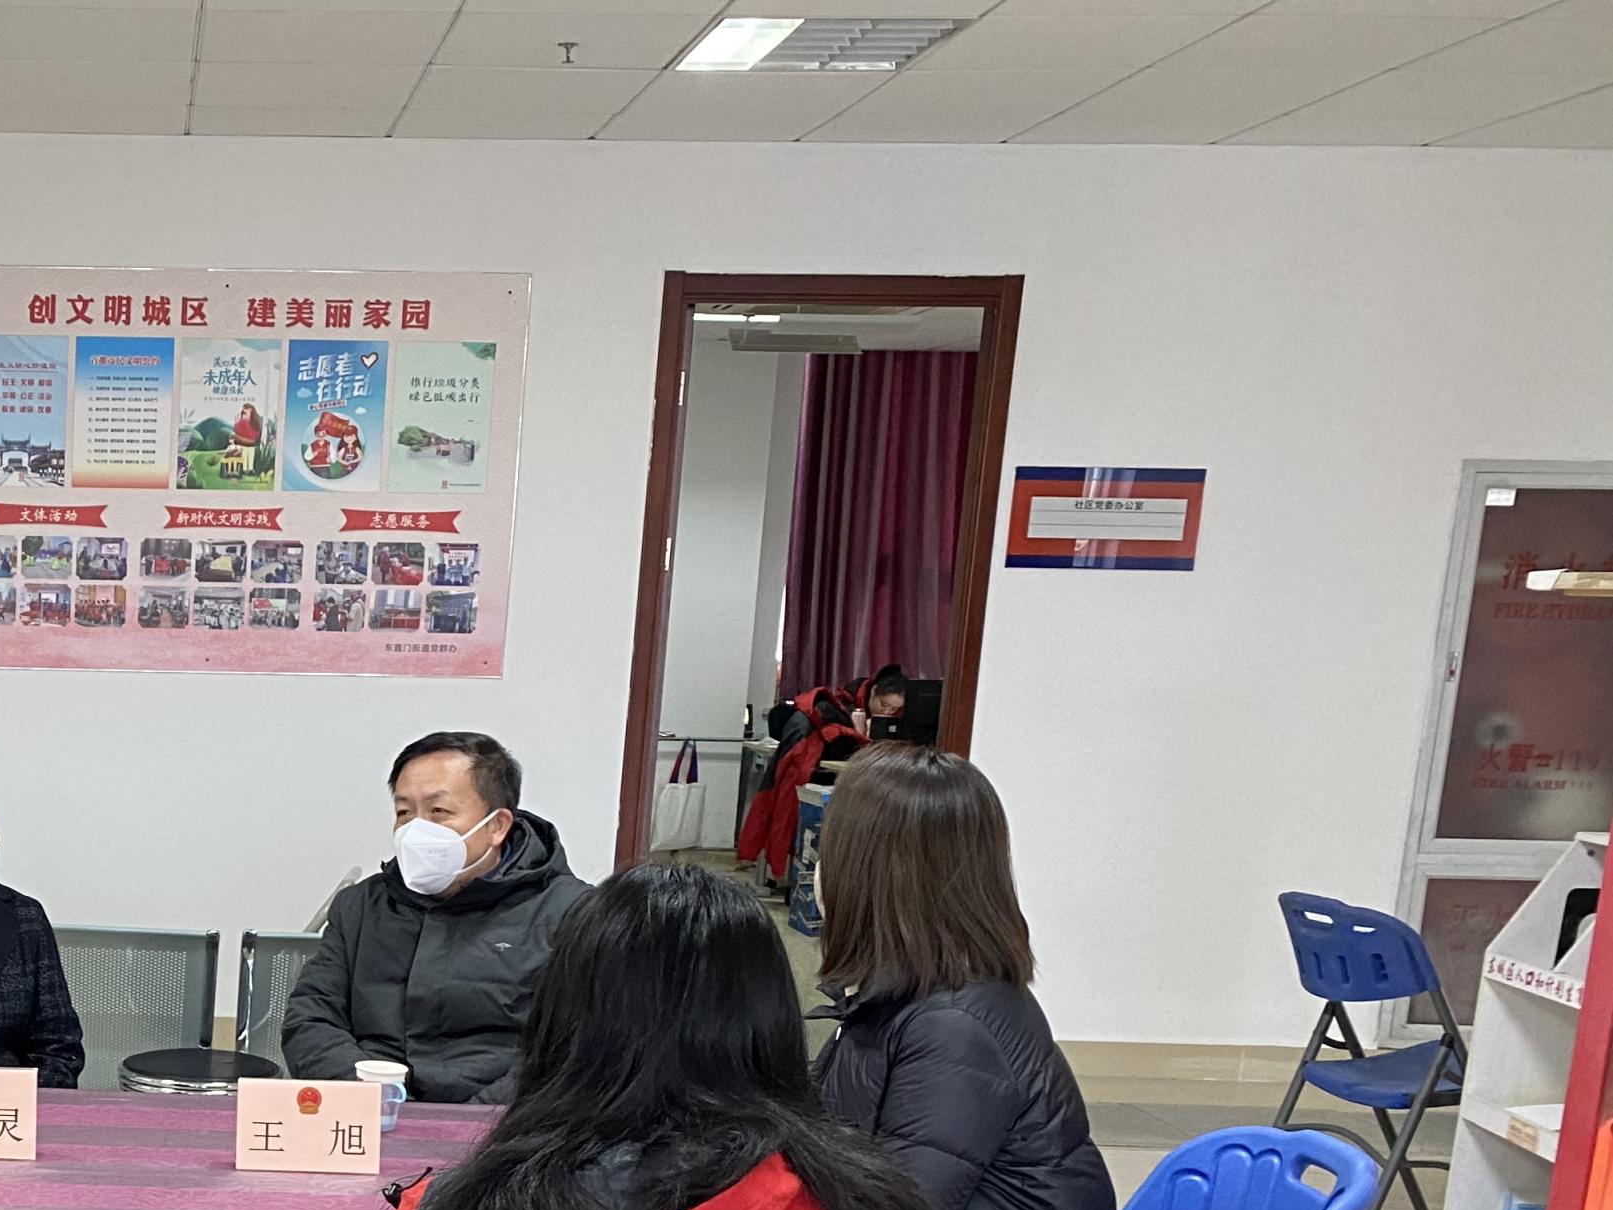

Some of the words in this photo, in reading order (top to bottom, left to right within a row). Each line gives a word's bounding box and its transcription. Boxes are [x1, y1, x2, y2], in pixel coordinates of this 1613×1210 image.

[28, 294, 208, 327] 创文明城区
[247, 298, 431, 330] 建美丽家园
[298, 352, 354, 381] 志愿者
[203, 368, 257, 386] 未成年人
[410, 377, 481, 390] 推行垃圾分类
[212, 385, 245, 395] 健康成长
[316, 374, 372, 402] 在行动
[409, 391, 481, 403] 绿色低碳出行
[1074, 500, 1145, 511] 社区党委办公室
[20, 507, 78, 523] 文体活动
[176, 511, 271, 527] 新时代文明实践
[370, 512, 431, 530] 志愿服务
[385, 643, 457, 654] 东直门街道党群办
[1476, 744, 1535, 772] 火警
[249, 1119, 366, 1156] 王旭
